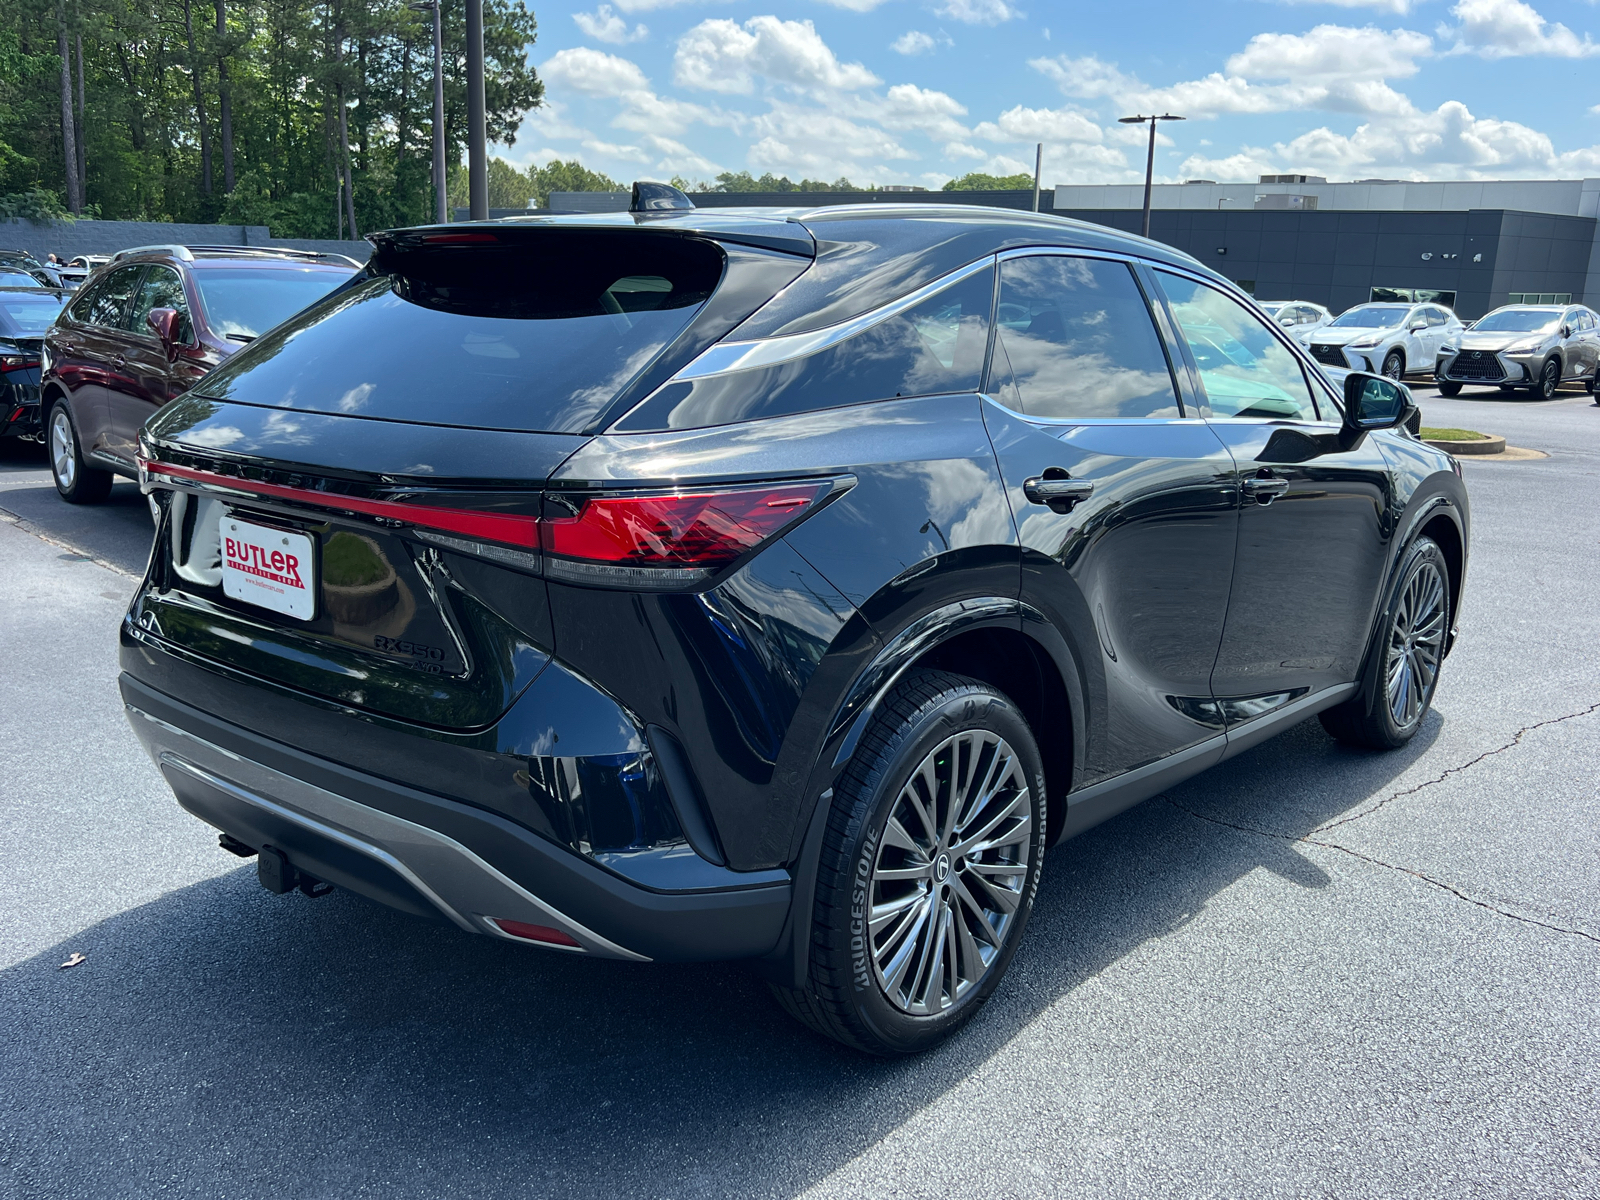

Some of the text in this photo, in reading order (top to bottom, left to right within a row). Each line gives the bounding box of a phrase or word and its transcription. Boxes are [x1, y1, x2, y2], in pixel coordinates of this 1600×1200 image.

[227, 560, 303, 588] AUTOMOTIVE GROUP
[410, 660, 444, 674] AWD
[1027, 773, 1047, 910] BRIDGESTONE
[850, 824, 878, 993] BRIDGESTONE
